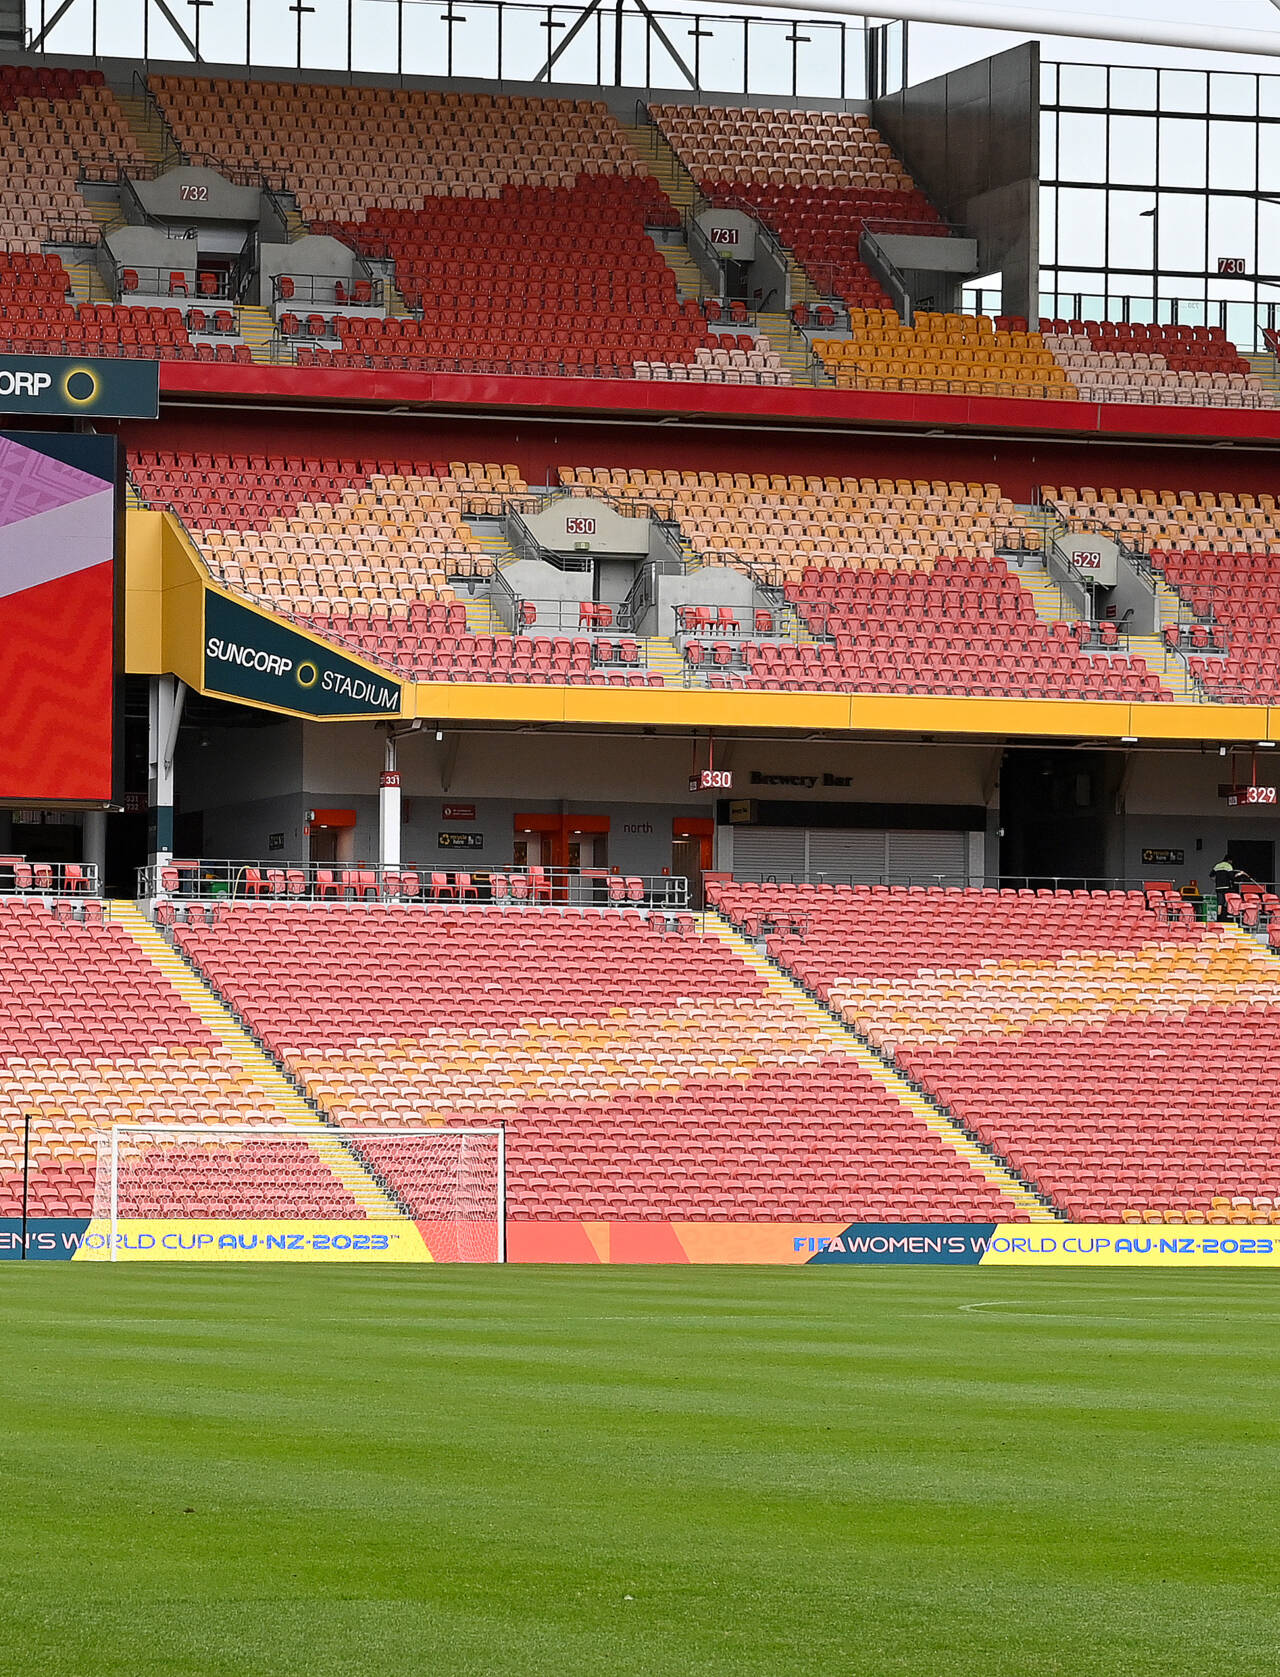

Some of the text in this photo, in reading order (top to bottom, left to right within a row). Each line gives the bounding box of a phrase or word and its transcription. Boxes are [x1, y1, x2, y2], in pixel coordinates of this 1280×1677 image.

[181, 185, 207, 201] 732
[713, 229, 736, 243] 731
[1219, 258, 1245, 274] 730
[567, 518, 595, 534] 530
[1073, 552, 1100, 567] 529
[206, 638, 399, 710] SUNCORP STADIUM
[385, 775, 400, 785] 331
[702, 770, 732, 788] 330
[750, 771, 854, 788] Brewery Bar
[1248, 787, 1276, 803] 329
[623, 822, 653, 833] north
[162, 1234, 214, 1250] CUP
[793, 1237, 847, 1252] FIFA
[847, 1237, 965, 1253] WOMEN'S
[970, 1237, 1057, 1253] WORLD
[1063, 1238, 1111, 1253] CUP
